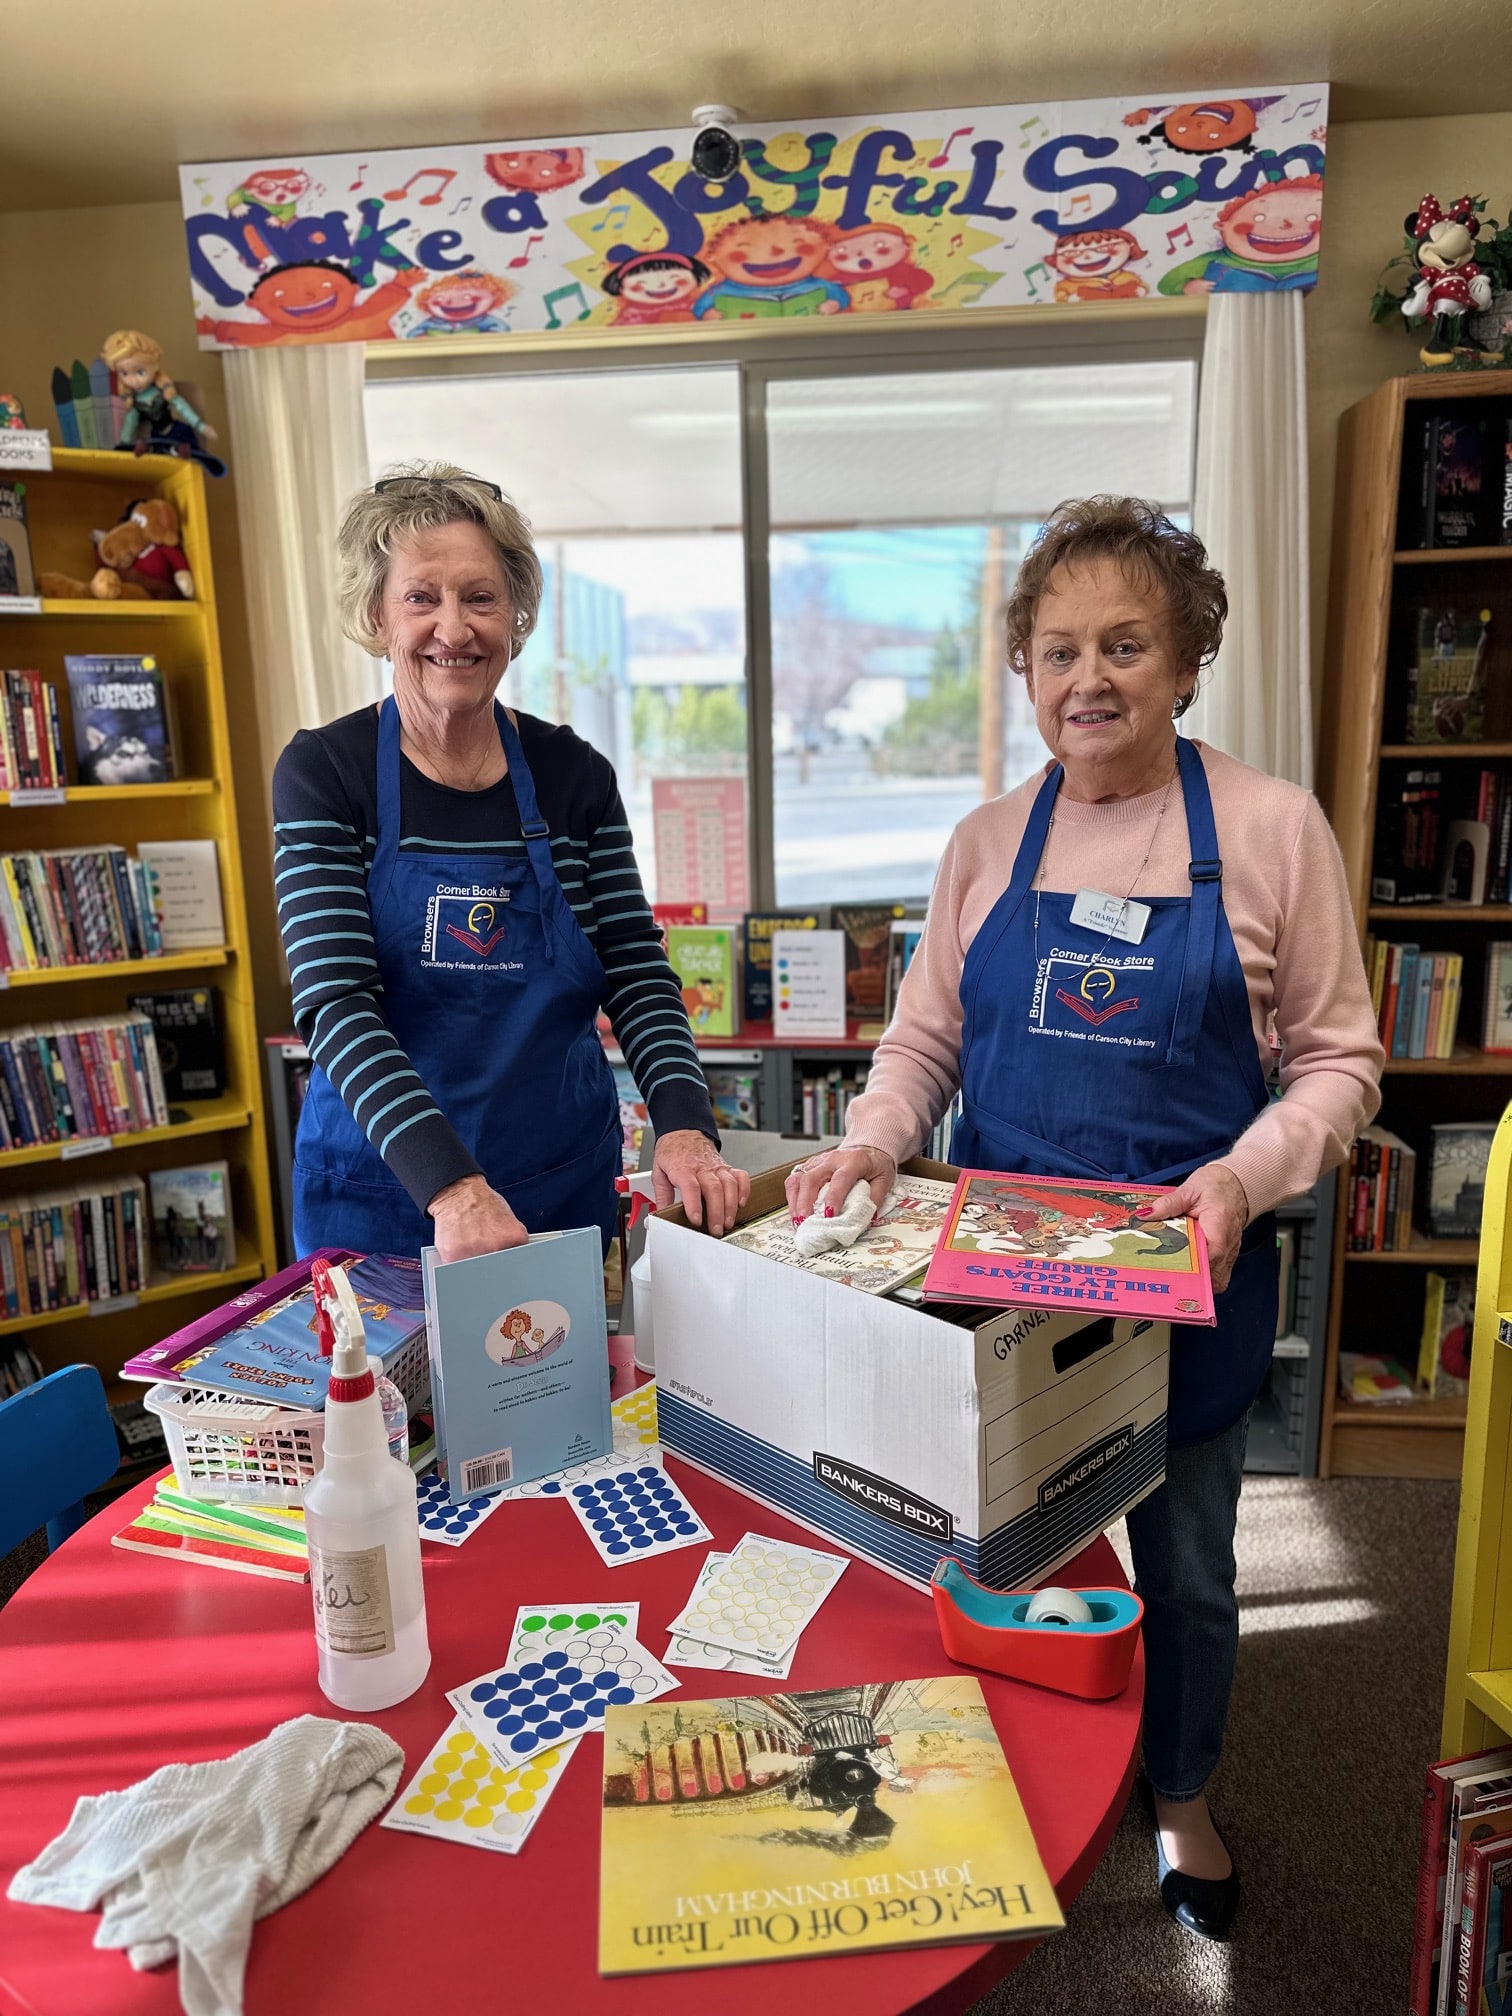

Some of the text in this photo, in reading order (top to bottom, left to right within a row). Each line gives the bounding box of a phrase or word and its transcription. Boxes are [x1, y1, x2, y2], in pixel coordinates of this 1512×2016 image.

[186, 198, 474, 307] Make
[482, 191, 548, 233] a
[75, 682, 156, 711] WILDERNESS
[437, 884, 470, 896] Corner
[472, 885, 498, 897] Book
[421, 896, 435, 953] Browsers
[420, 960, 446, 968] Operated
[455, 962, 476, 970] Friends
[1050, 948, 1155, 967] Corner Book Store
[1029, 958, 1048, 1018] Browsers
[1028, 1025, 1054, 1036] Operated
[1055, 1029, 1063, 1037] by
[1064, 1030, 1087, 1040] Friends
[1095, 1034, 1118, 1044] Carson
[1119, 1036, 1132, 1046] City
[1133, 1038, 1156, 1049] Library
[966, 1264, 1170, 1294] BILLY GOATS
[1016, 1259, 1118, 1276] GRUFF
[1012, 1282, 1119, 1301] THREE
[246, 1341, 298, 1357] KING
[221, 1361, 314, 1384] SOUND STORY
[229, 1372, 288, 1388] GOLDEN
[1043, 1434, 1130, 1504] BANKERS BOX
[821, 1463, 946, 1532] BANKERS BOX
[675, 1860, 972, 1919] JOHN BURNINGHAM
[632, 1884, 1037, 1957] Hey! Get Off Our Train
[1462, 1904, 1475, 1936] BIG
[1459, 1933, 1474, 1977] BOOK
[1457, 1979, 1469, 2002] OF
